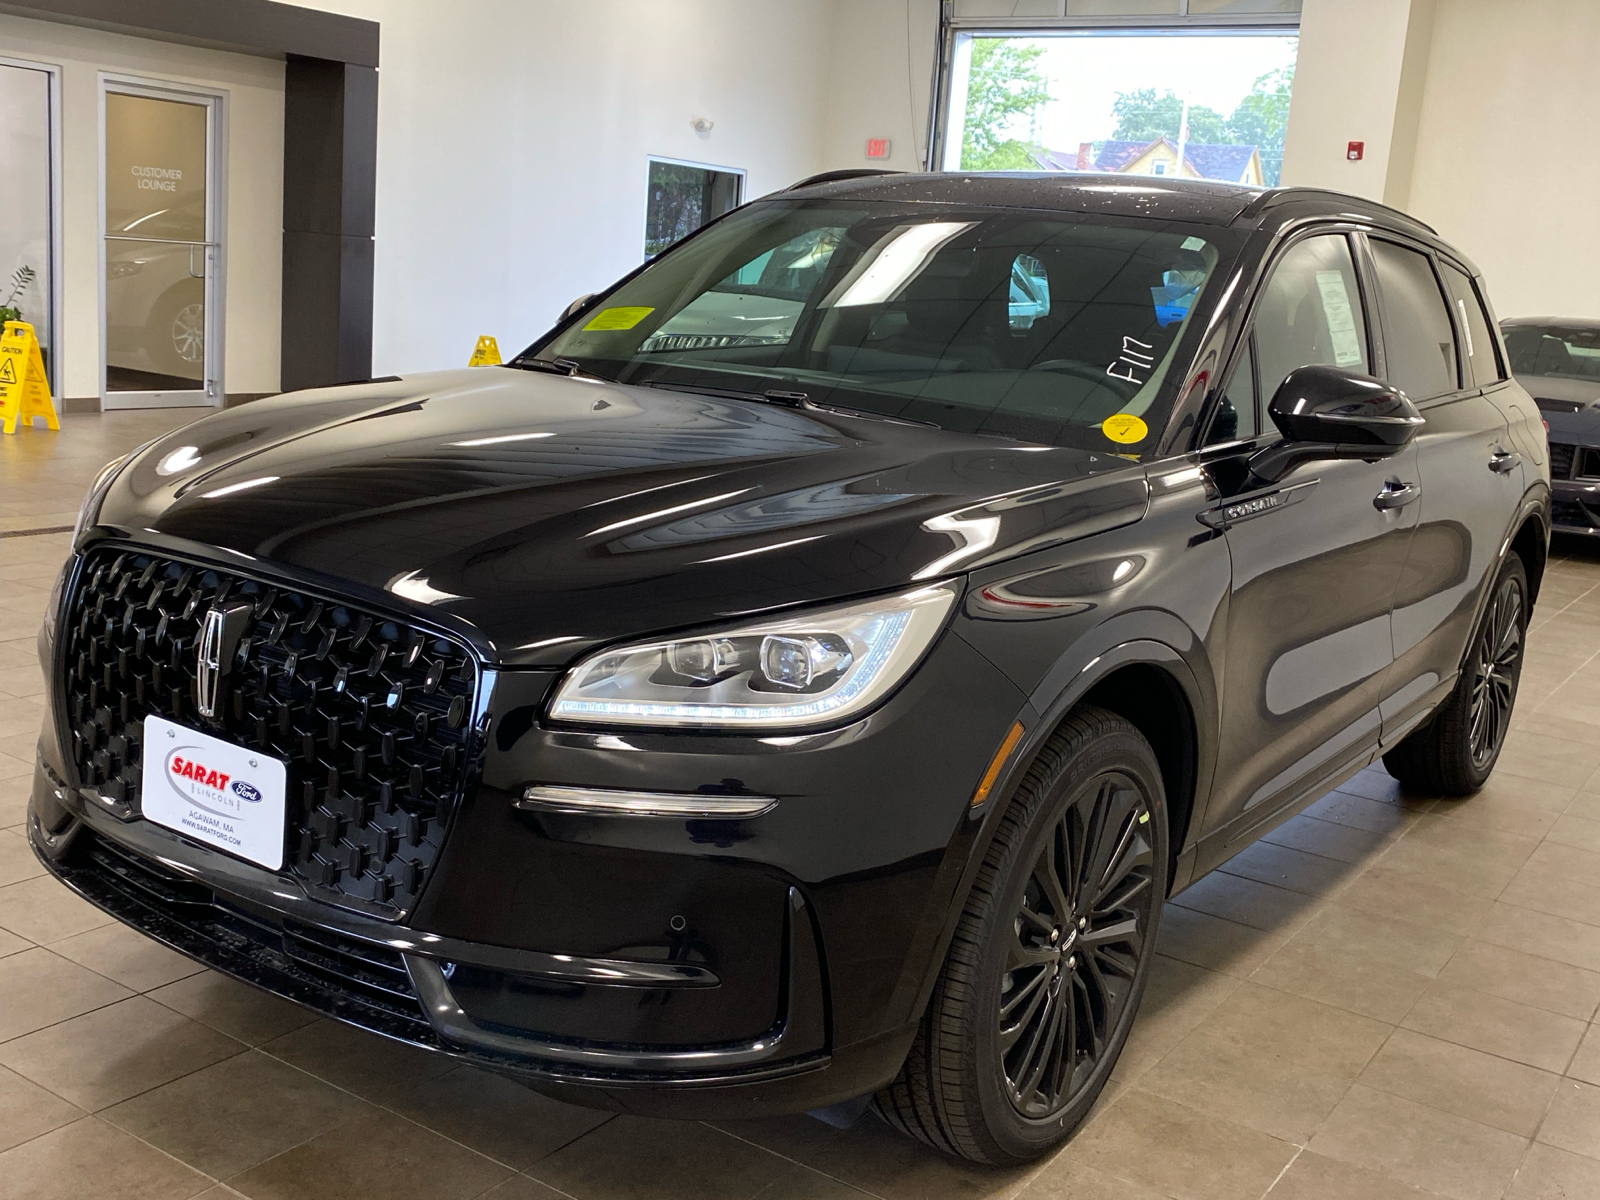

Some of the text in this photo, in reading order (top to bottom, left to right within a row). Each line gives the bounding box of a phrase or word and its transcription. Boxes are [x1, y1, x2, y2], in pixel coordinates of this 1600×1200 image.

[867, 139, 887, 156] EXIT
[131, 165, 182, 180] CUSTOMER
[137, 178, 176, 192] LOUNGE
[1, 346, 23, 355] CAUTION
[1228, 495, 1278, 518] CORSAIR
[171, 756, 230, 791] SARAT
[196, 786, 235, 807] LINCOLN
[235, 783, 257, 801] Ford
[181, 816, 241, 846] WWW.SARATFORD.COM
[188, 810, 235, 833] AGAWAM, MA
